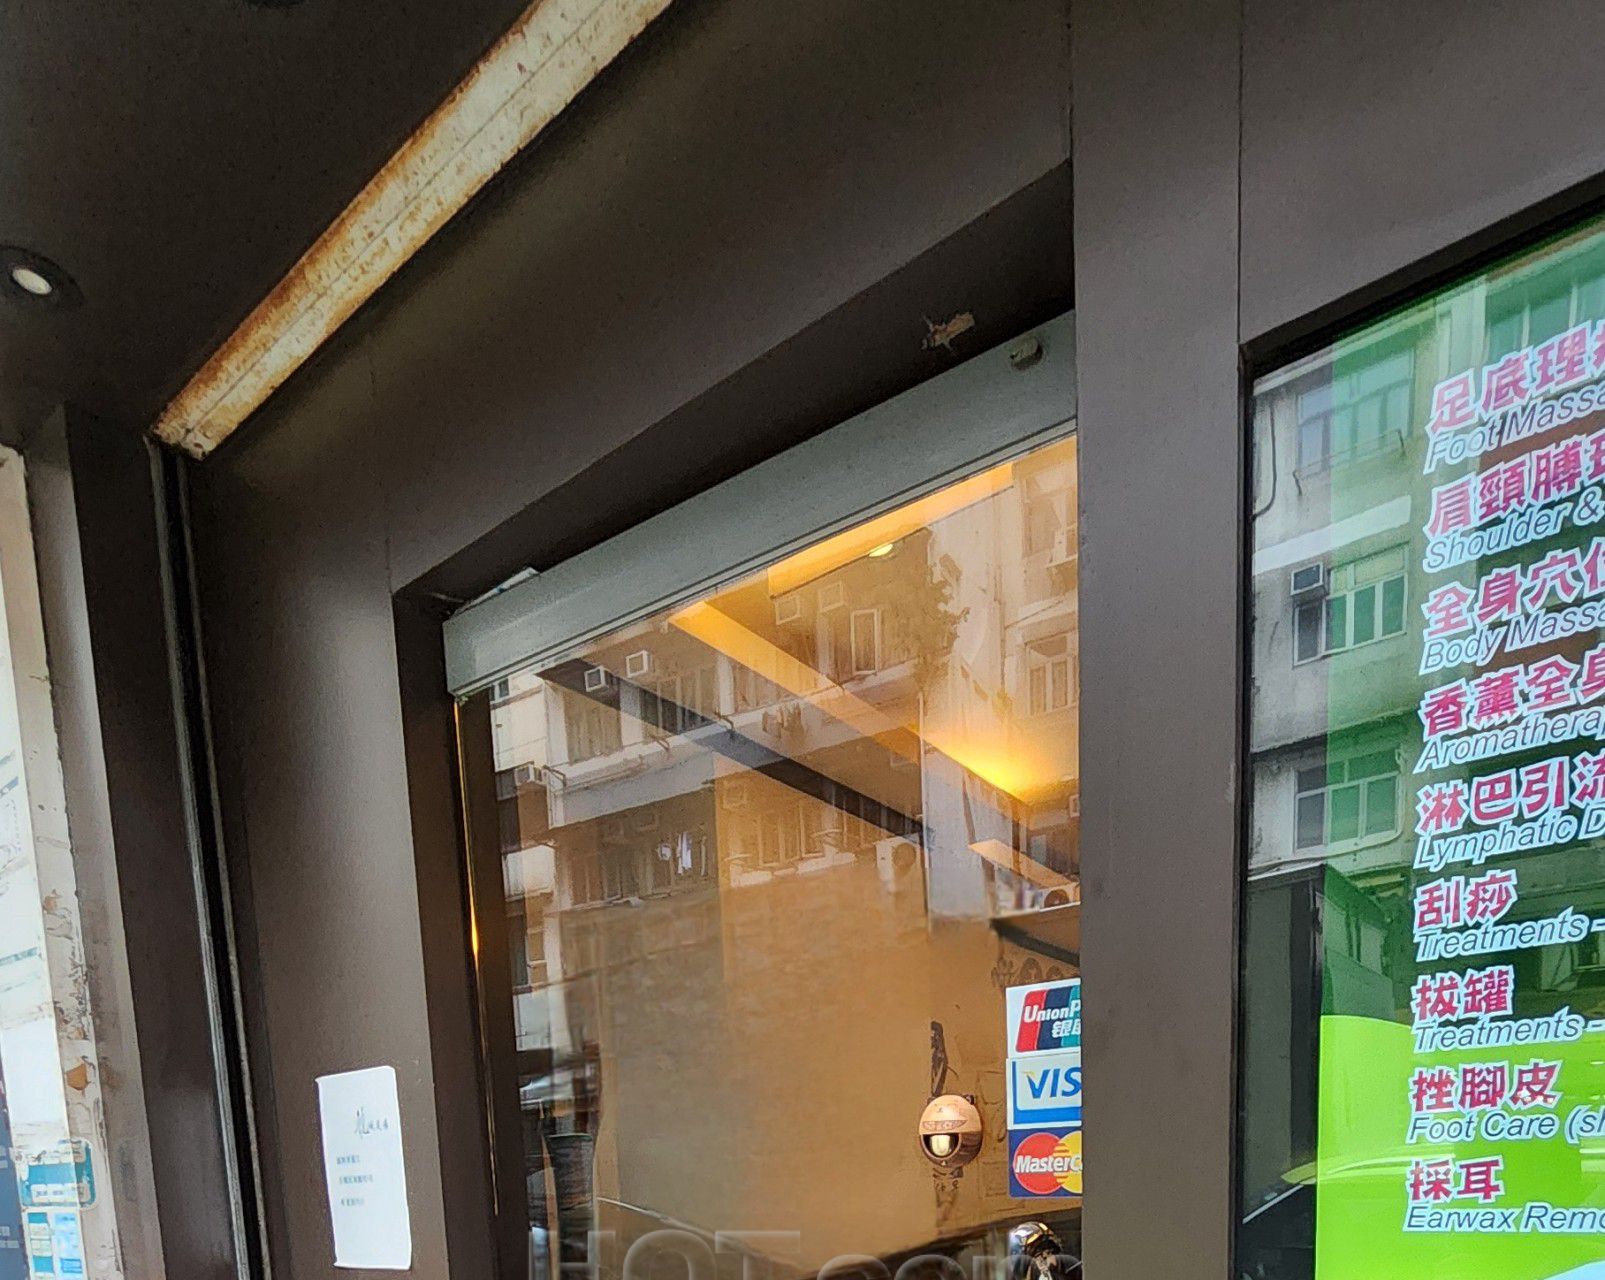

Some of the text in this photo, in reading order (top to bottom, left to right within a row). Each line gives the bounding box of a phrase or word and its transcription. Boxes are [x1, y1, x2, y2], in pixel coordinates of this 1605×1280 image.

[1429, 323, 1605, 434] 足底理
[1427, 419, 1498, 471] Foot
[1426, 489, 1601, 570] Shoulder &
[1425, 628, 1503, 669] Body
[1418, 709, 1605, 769] Aromathera
[1418, 813, 1573, 867] Lymphatic
[1417, 873, 1513, 929] 刮痧
[1418, 912, 1584, 957] Treatments
[1415, 969, 1510, 1021] 拔罐
[1415, 1015, 1580, 1050] Treatments
[1024, 1066, 1081, 1099] VIS
[1409, 1113, 1475, 1140] Foot
[1484, 1112, 1556, 1138] Care
[1409, 1159, 1501, 1201] 採耳
[1406, 1205, 1516, 1230] Earwax
